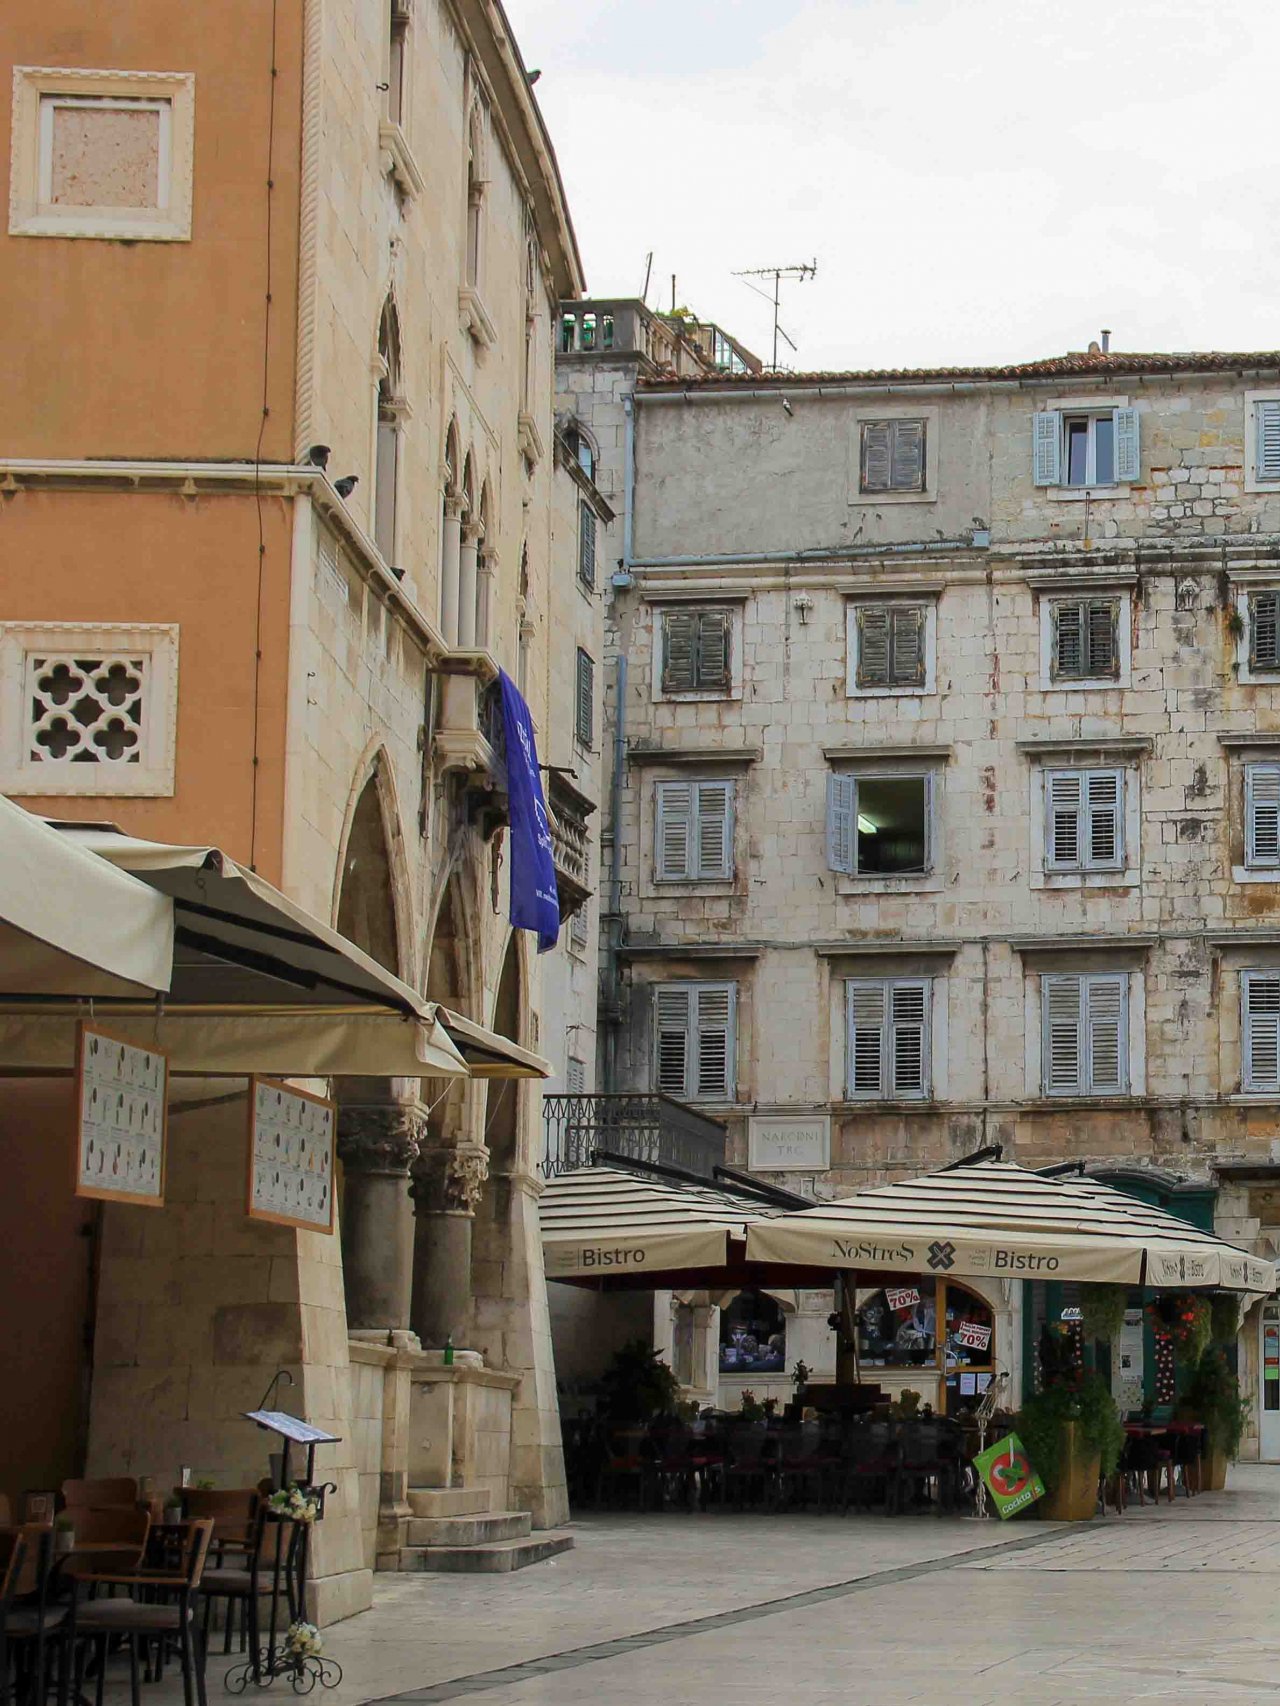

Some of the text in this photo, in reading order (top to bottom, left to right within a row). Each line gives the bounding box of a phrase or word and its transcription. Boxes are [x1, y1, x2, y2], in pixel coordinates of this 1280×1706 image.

[582, 1248, 645, 1267] Bistro
[994, 1250, 1060, 1271] Bistro
[889, 1290, 919, 1309] 70%
[960, 1334, 986, 1349] 70%
[1002, 1485, 1041, 1514] Cocktas
